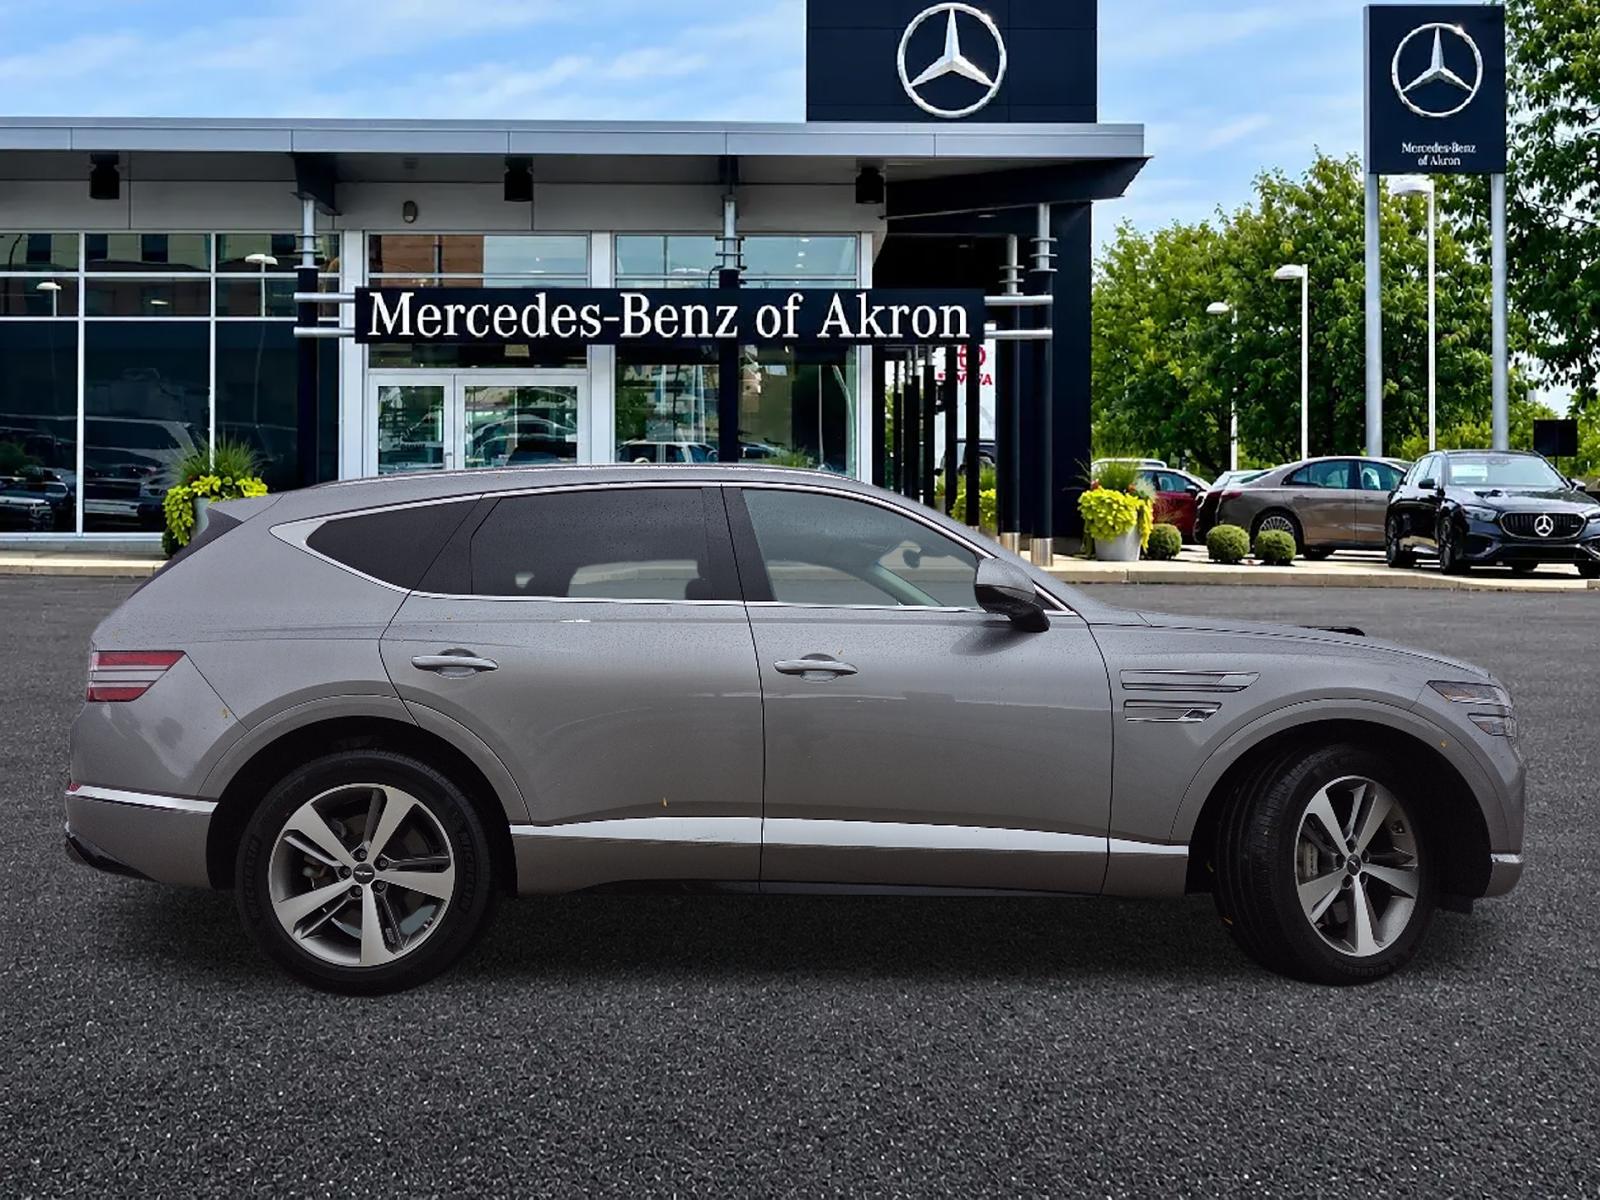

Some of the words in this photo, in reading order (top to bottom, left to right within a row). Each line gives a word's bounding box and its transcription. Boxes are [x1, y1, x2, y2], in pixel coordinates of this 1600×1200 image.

[1401, 142, 1476, 153] Mercedes-Benz
[1418, 155, 1428, 165] of
[1430, 155, 1461, 165] Akron
[367, 289, 738, 338] Mercedes-Benz
[756, 288, 803, 338] of
[818, 289, 970, 338] Akron
